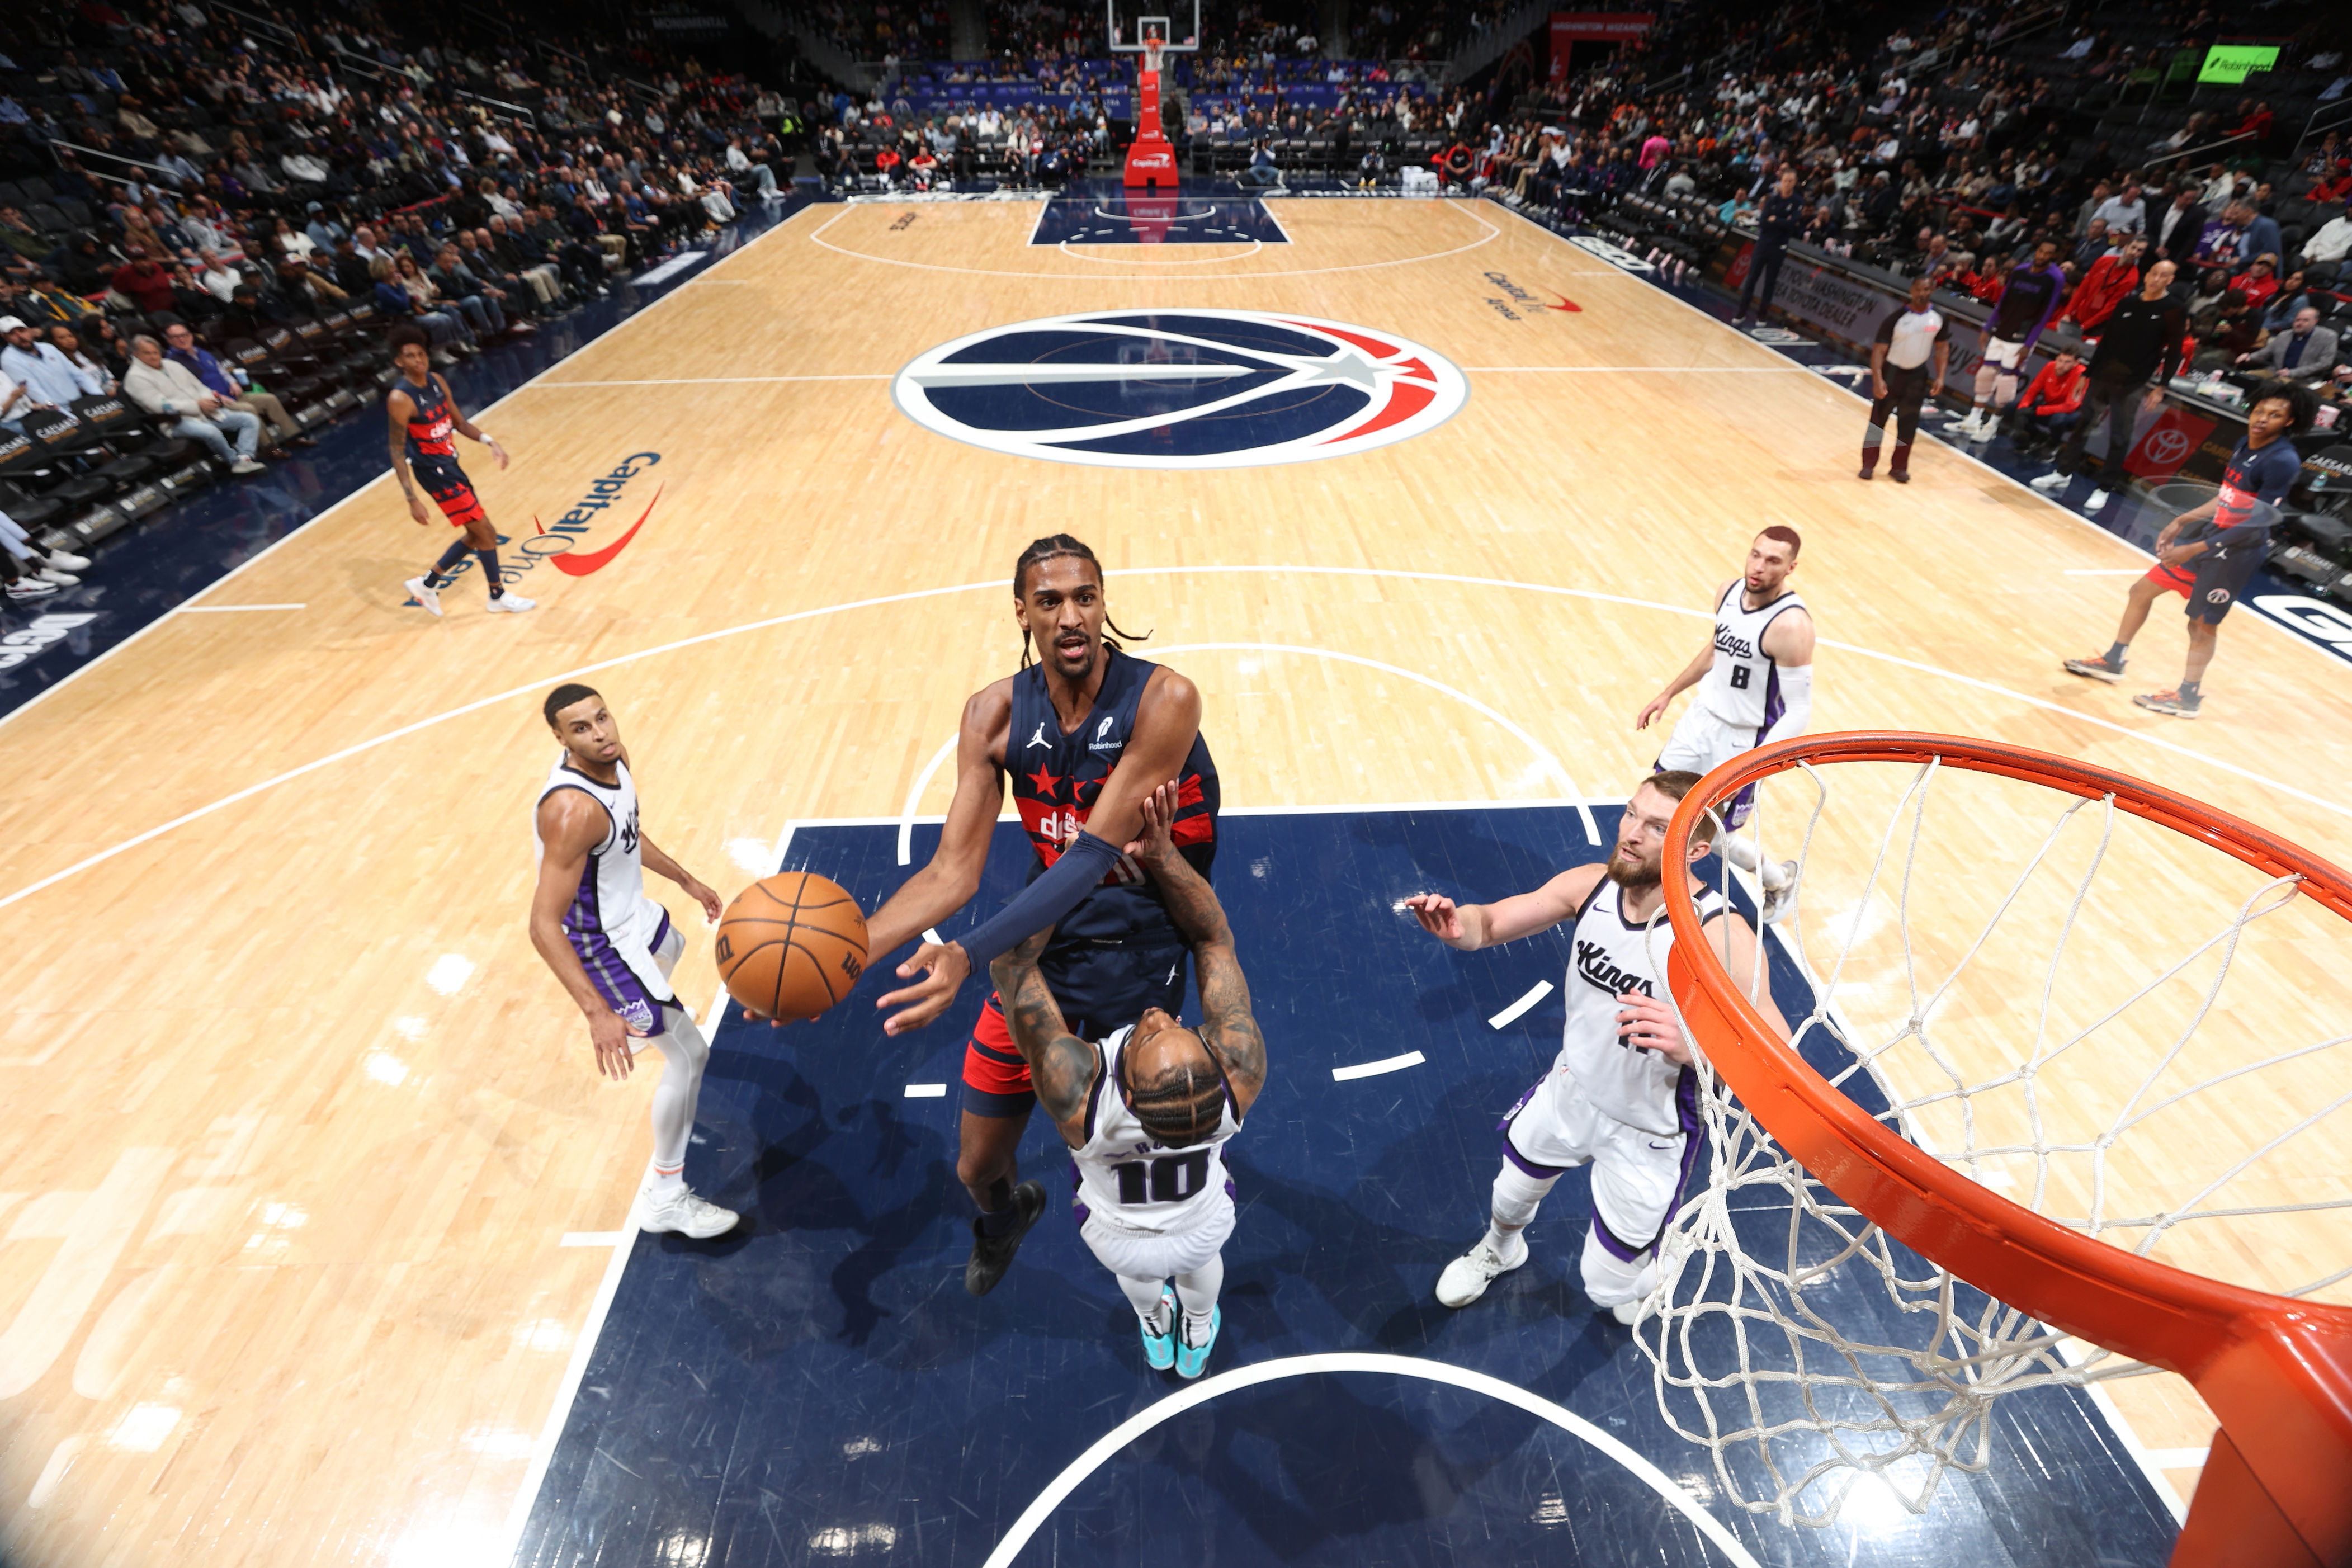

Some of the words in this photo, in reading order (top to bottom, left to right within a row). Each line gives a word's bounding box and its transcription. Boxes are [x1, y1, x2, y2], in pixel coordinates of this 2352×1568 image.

[2304, 453, 2352, 476] CAESAR
[548, 452, 662, 533] Capital
[1715, 623, 1753, 659] Kings
[1730, 664, 1751, 689] 8
[1089, 740, 1122, 750] Robinhood
[1577, 939, 1656, 1002] Kings
[1111, 1147, 1210, 1204] 10
